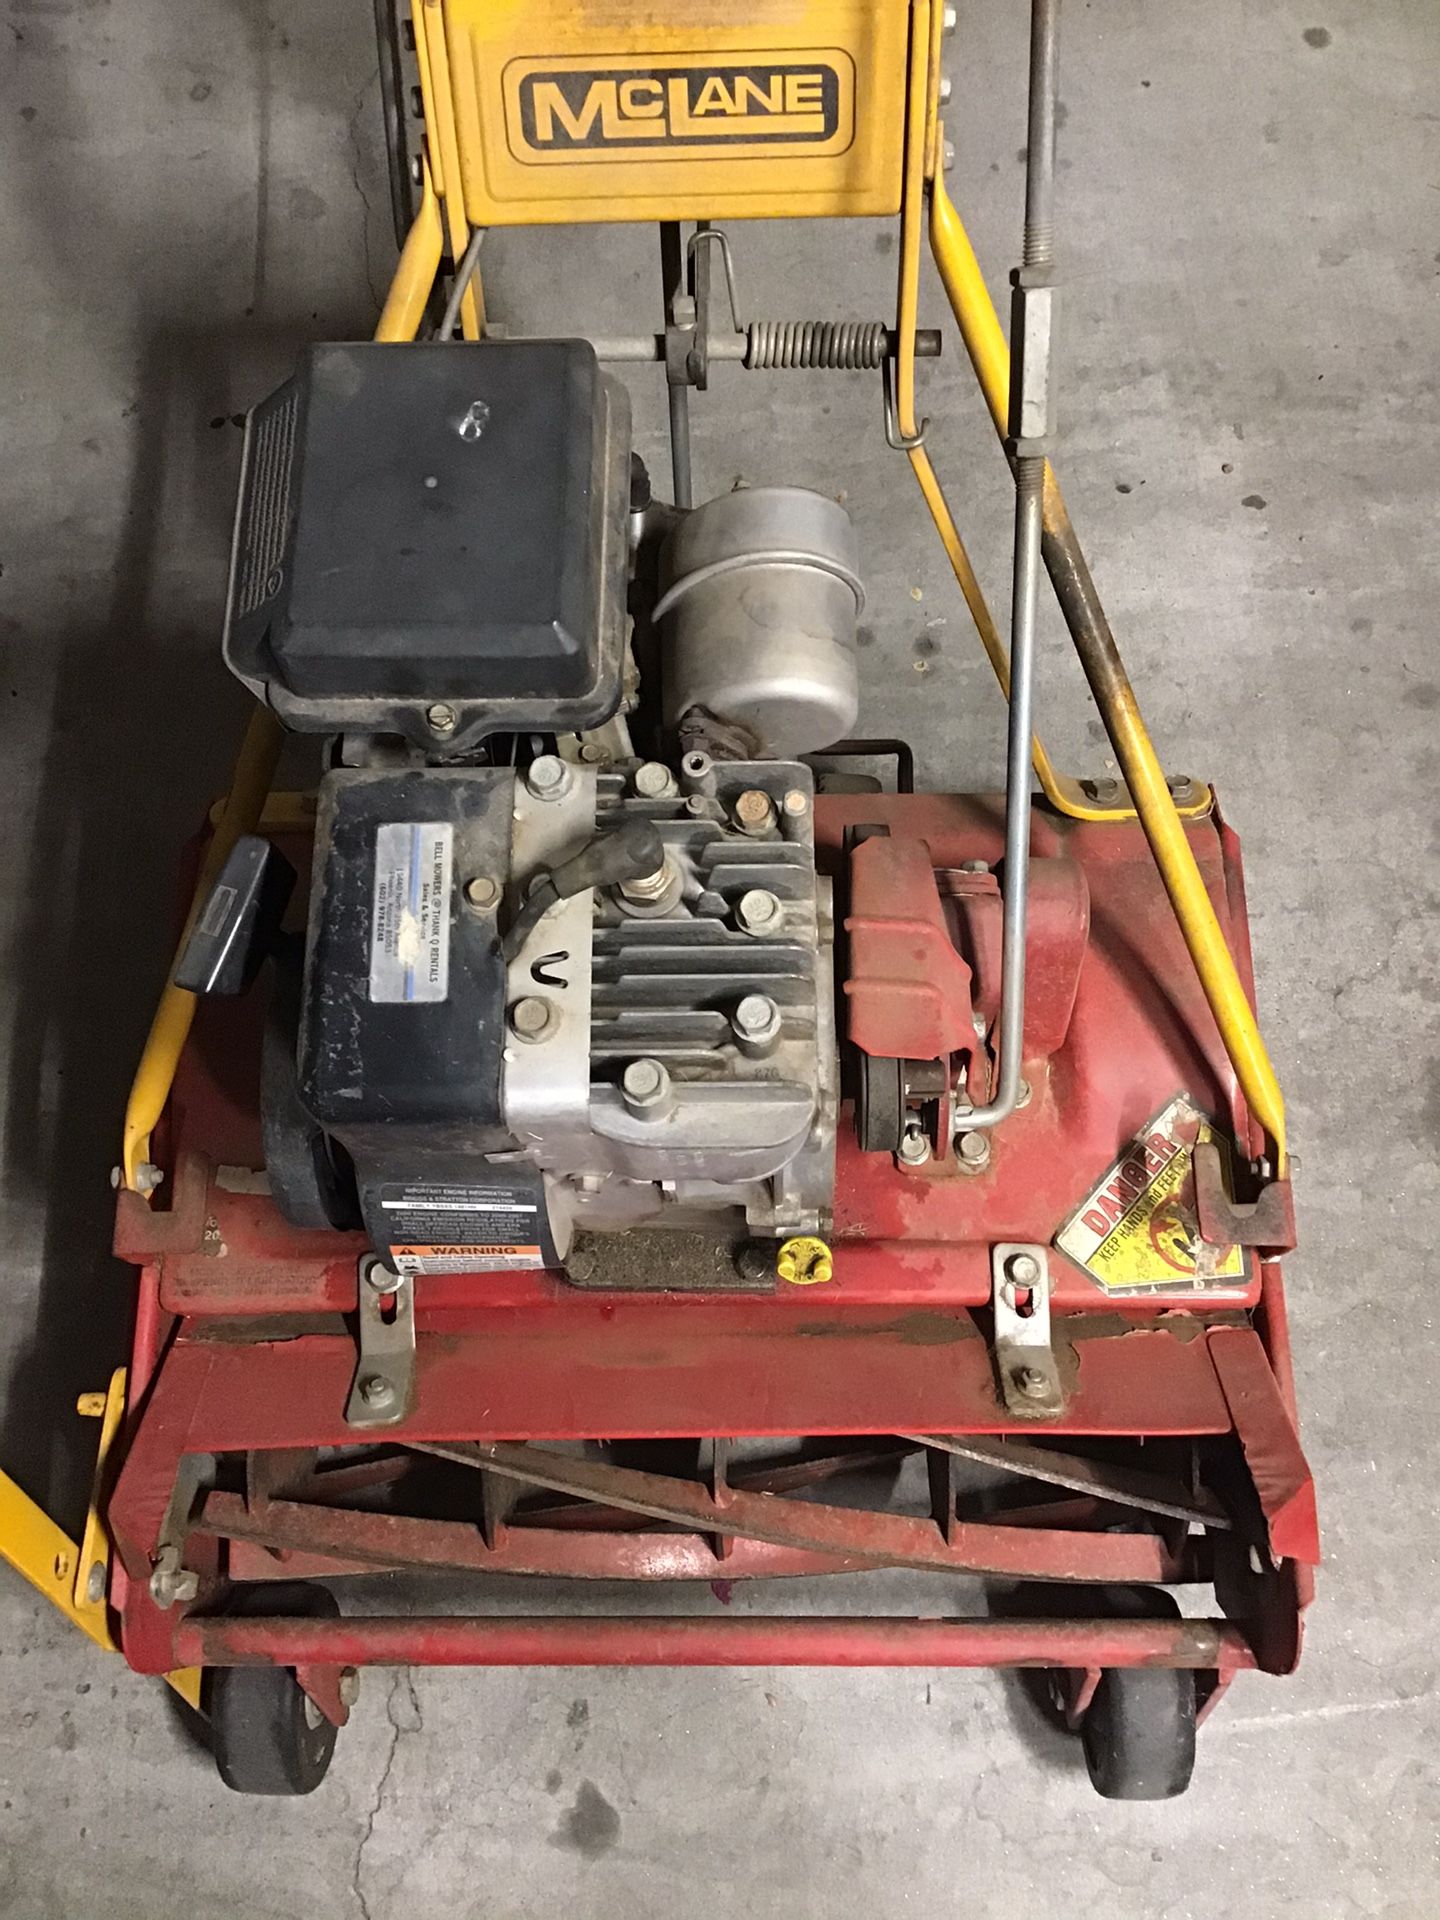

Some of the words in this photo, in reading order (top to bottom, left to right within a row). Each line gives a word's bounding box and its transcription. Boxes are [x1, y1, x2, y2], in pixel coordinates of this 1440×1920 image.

[433, 841, 443, 860] BELL
[432, 862, 442, 895] MOWERS
[378, 882, 386, 903] (602)
[432, 898, 441, 908] @
[431, 910, 441, 936] THANK
[429, 948, 439, 982] RENTALS
[1081, 1132, 1178, 1238] DANGER
[1098, 1237, 1121, 1263] KEEP
[1119, 1203, 1149, 1240] HANDS
[1157, 1166, 1182, 1197] FEET
[430, 1247, 517, 1255] WARNING
